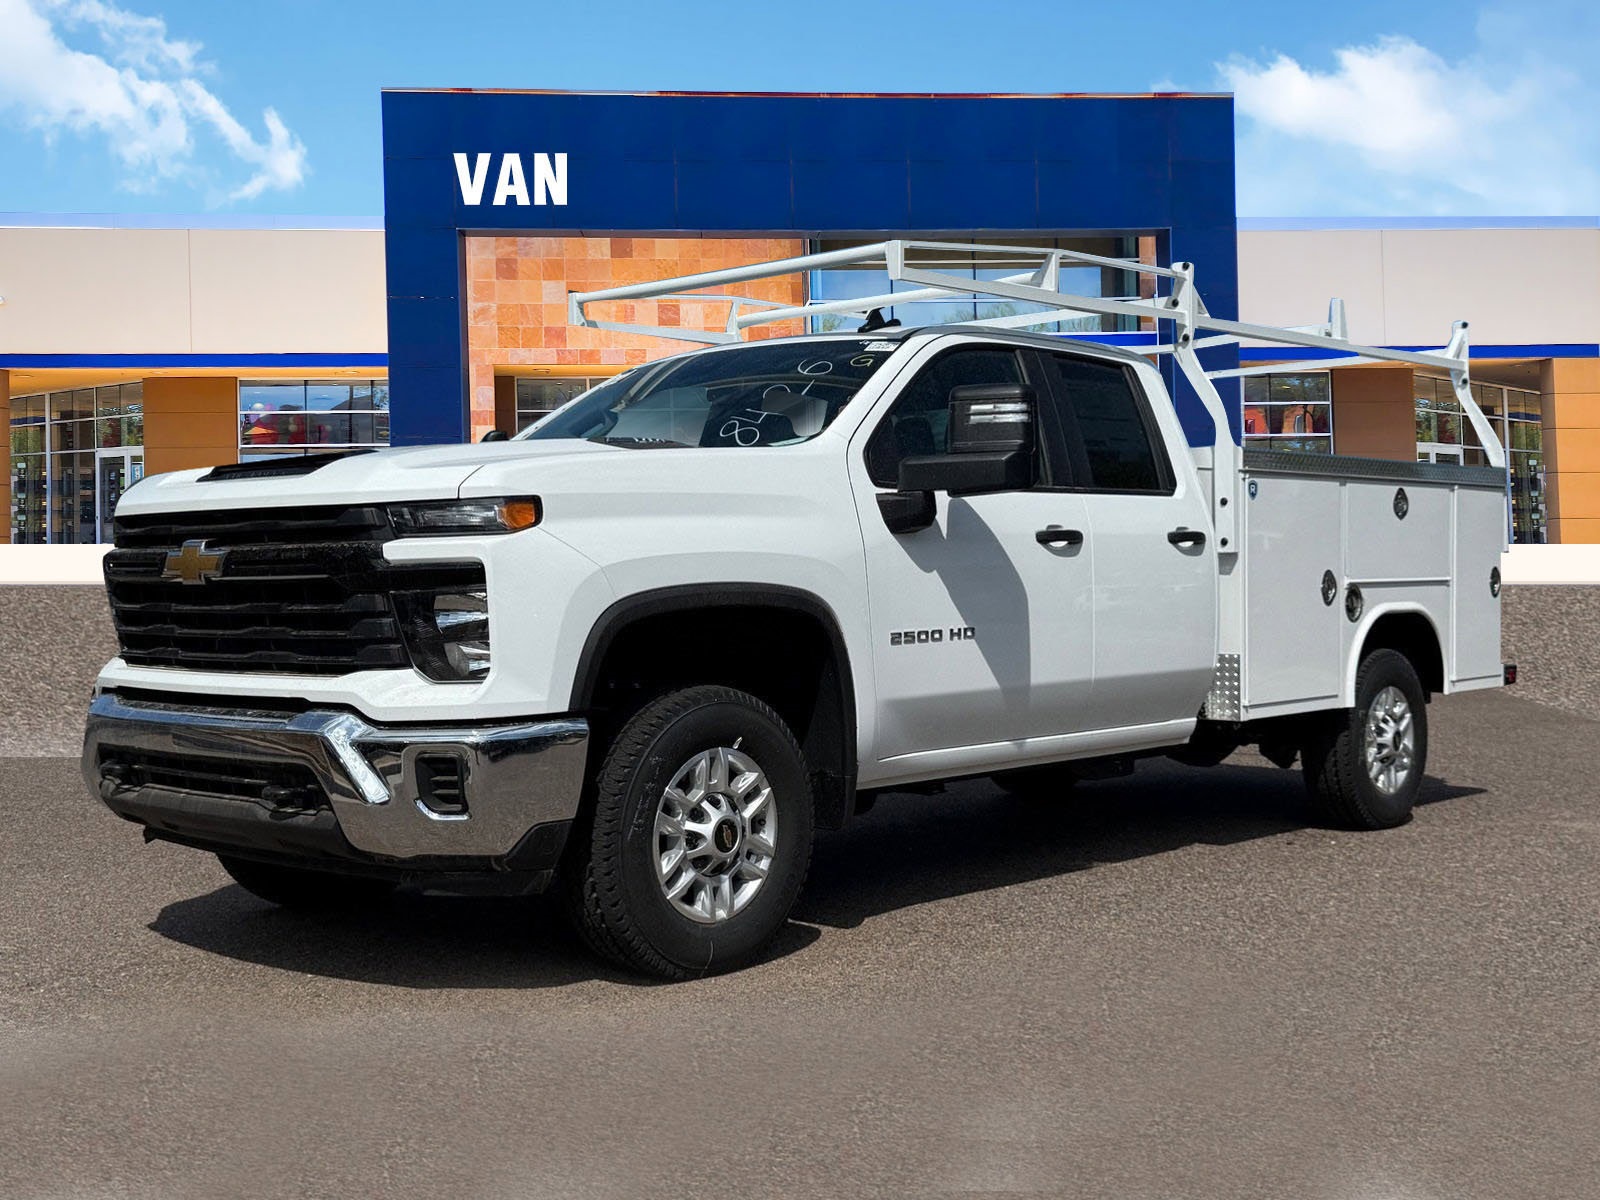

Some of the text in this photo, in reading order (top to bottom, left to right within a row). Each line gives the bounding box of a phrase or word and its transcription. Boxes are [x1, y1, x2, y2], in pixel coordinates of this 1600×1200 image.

[453, 153, 568, 206] VAN
[890, 626, 976, 646] 2500 HD
